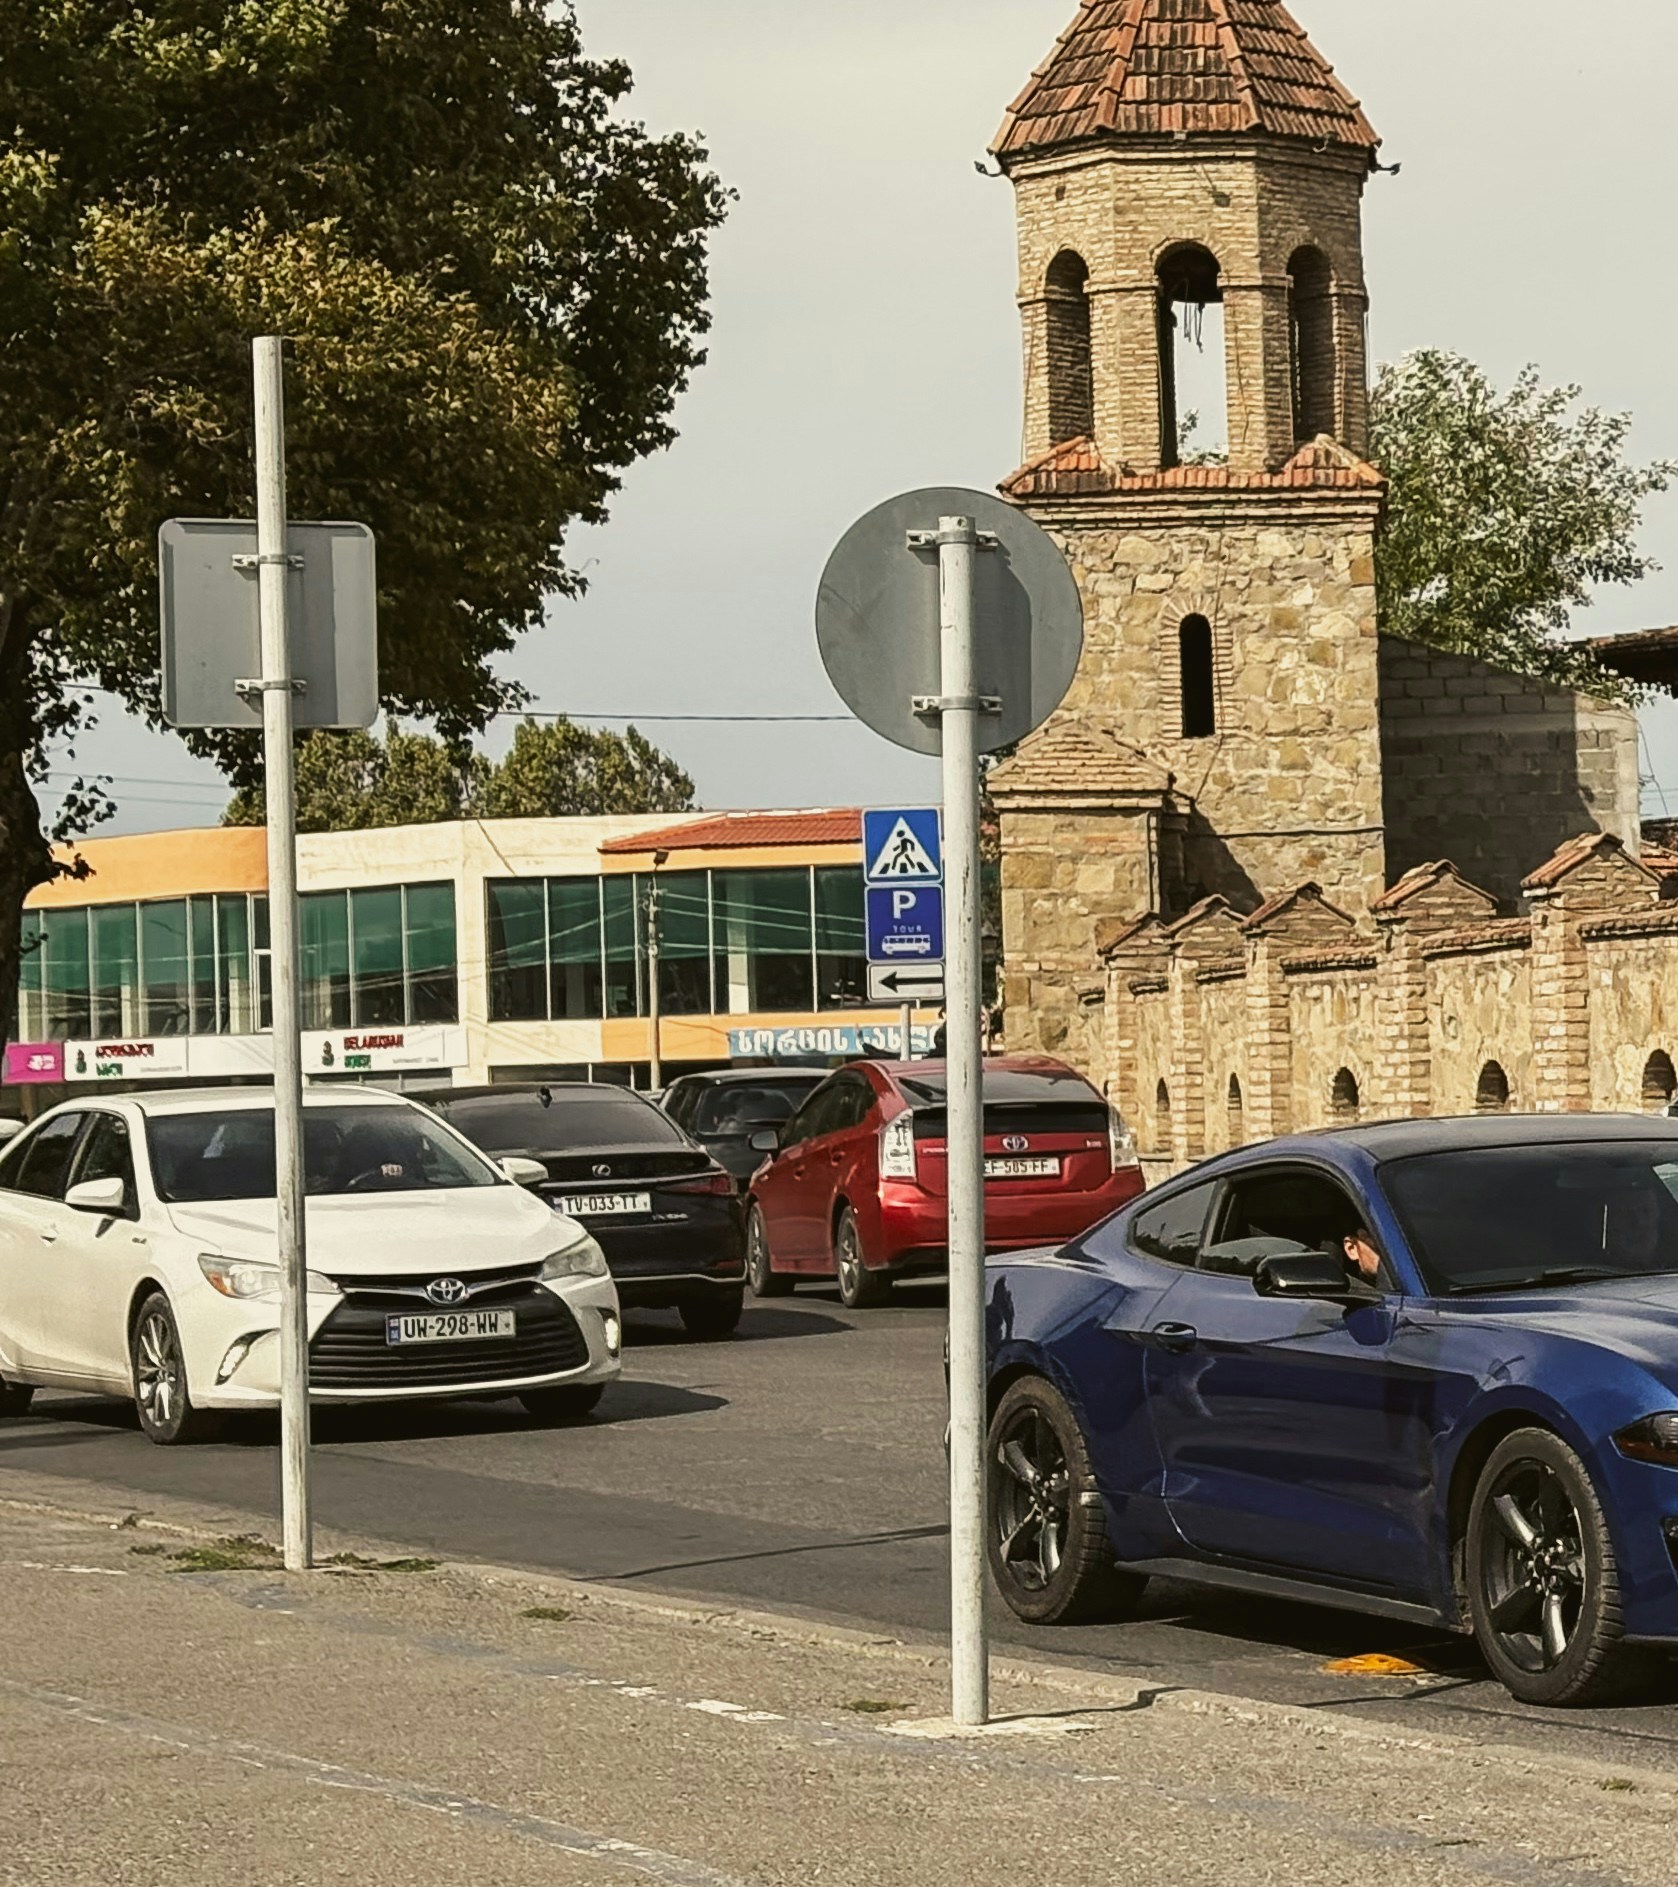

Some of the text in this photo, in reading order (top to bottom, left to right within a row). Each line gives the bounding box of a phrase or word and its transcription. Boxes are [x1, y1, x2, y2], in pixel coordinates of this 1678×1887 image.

[892, 890, 917, 919] P
[565, 1194, 639, 1213] TV-033-TT
[404, 1313, 499, 1338] UW-298-WW
